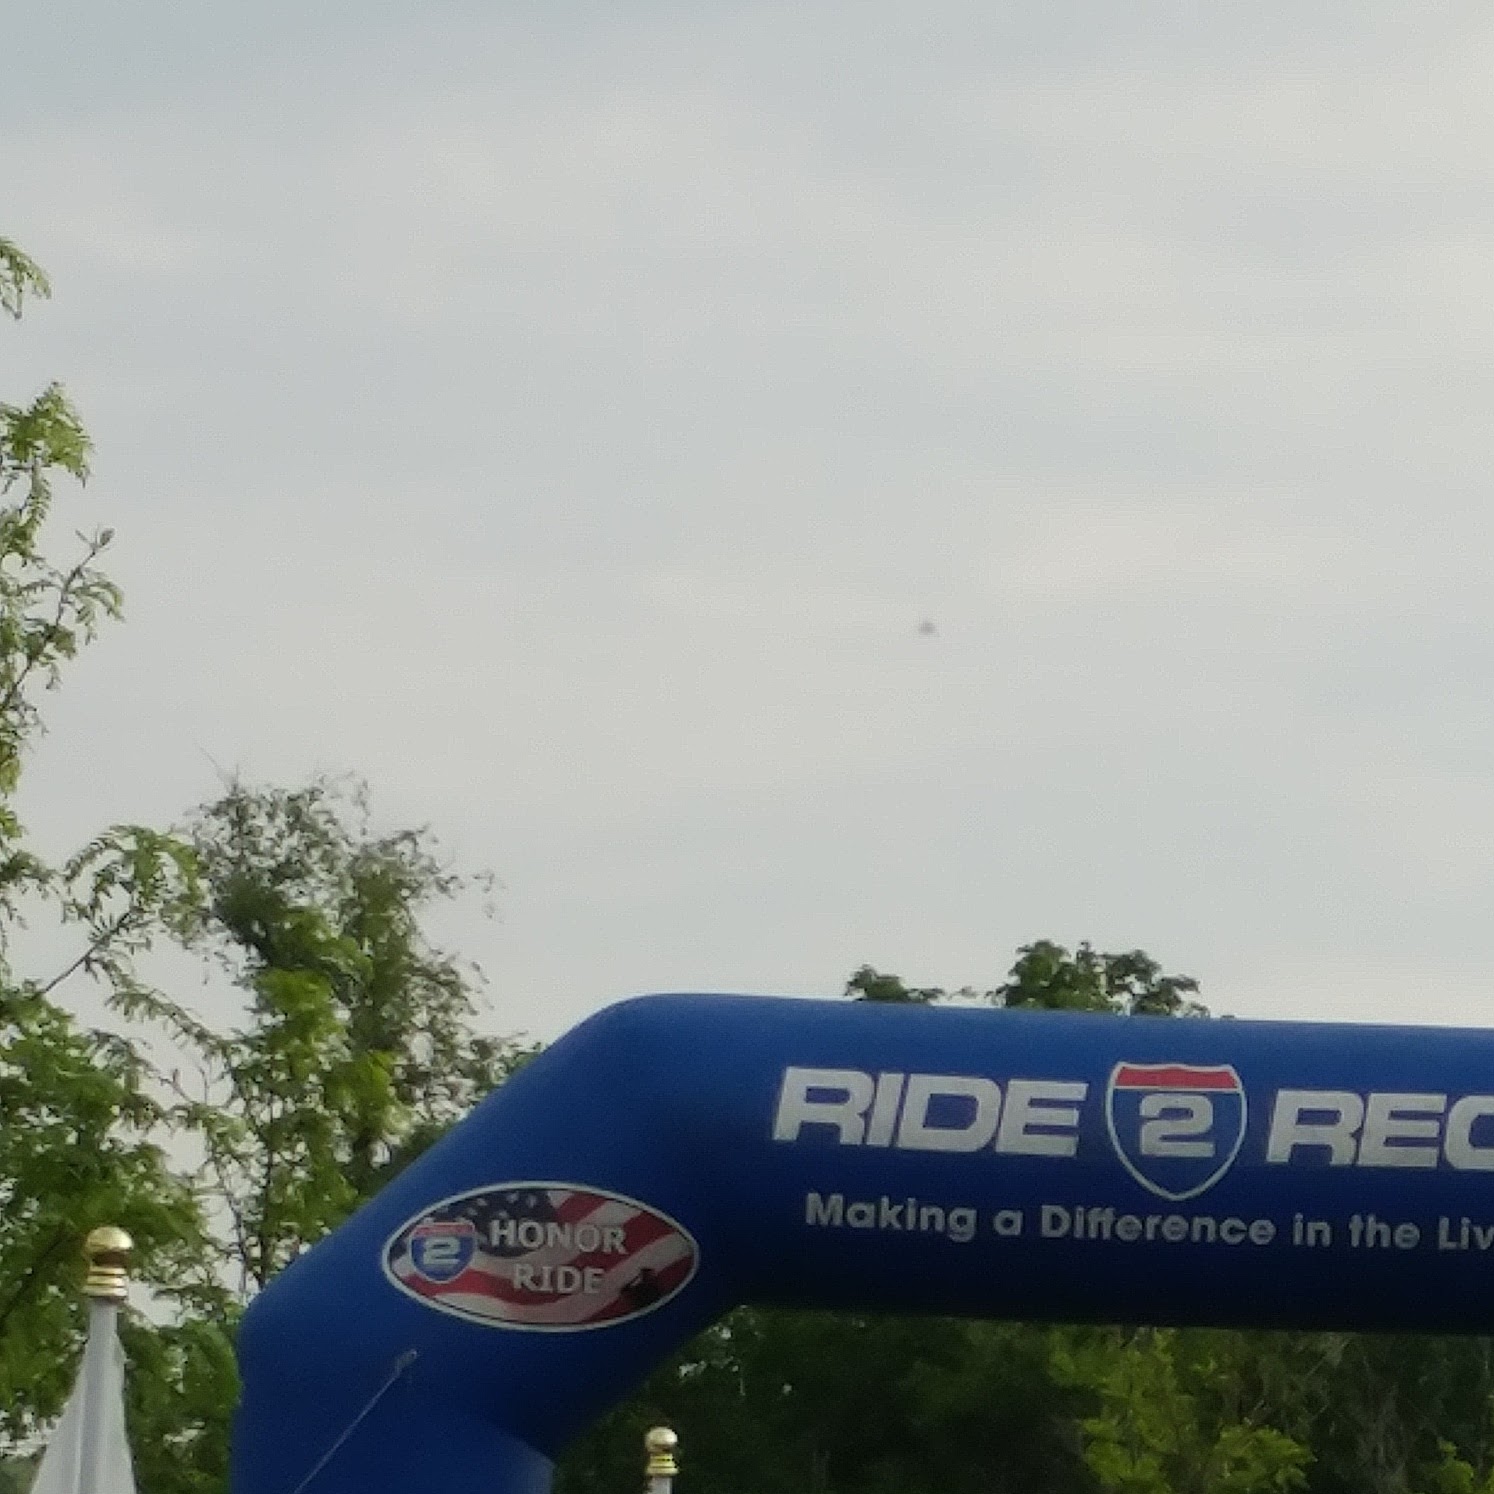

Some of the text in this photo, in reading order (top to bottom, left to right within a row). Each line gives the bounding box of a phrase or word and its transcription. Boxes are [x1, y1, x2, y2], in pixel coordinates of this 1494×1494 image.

[772, 1066, 1089, 1157] RIDE
[1139, 1092, 1215, 1158] 2
[489, 1219, 626, 1254] HONOR
[805, 1192, 977, 1242] Making
[993, 1211, 1023, 1236] a
[1041, 1204, 1275, 1245] Difference
[1293, 1213, 1331, 1247] in
[1350, 1214, 1420, 1249] the
[423, 1237, 460, 1265] 2
[512, 1263, 604, 1294] RIDE
